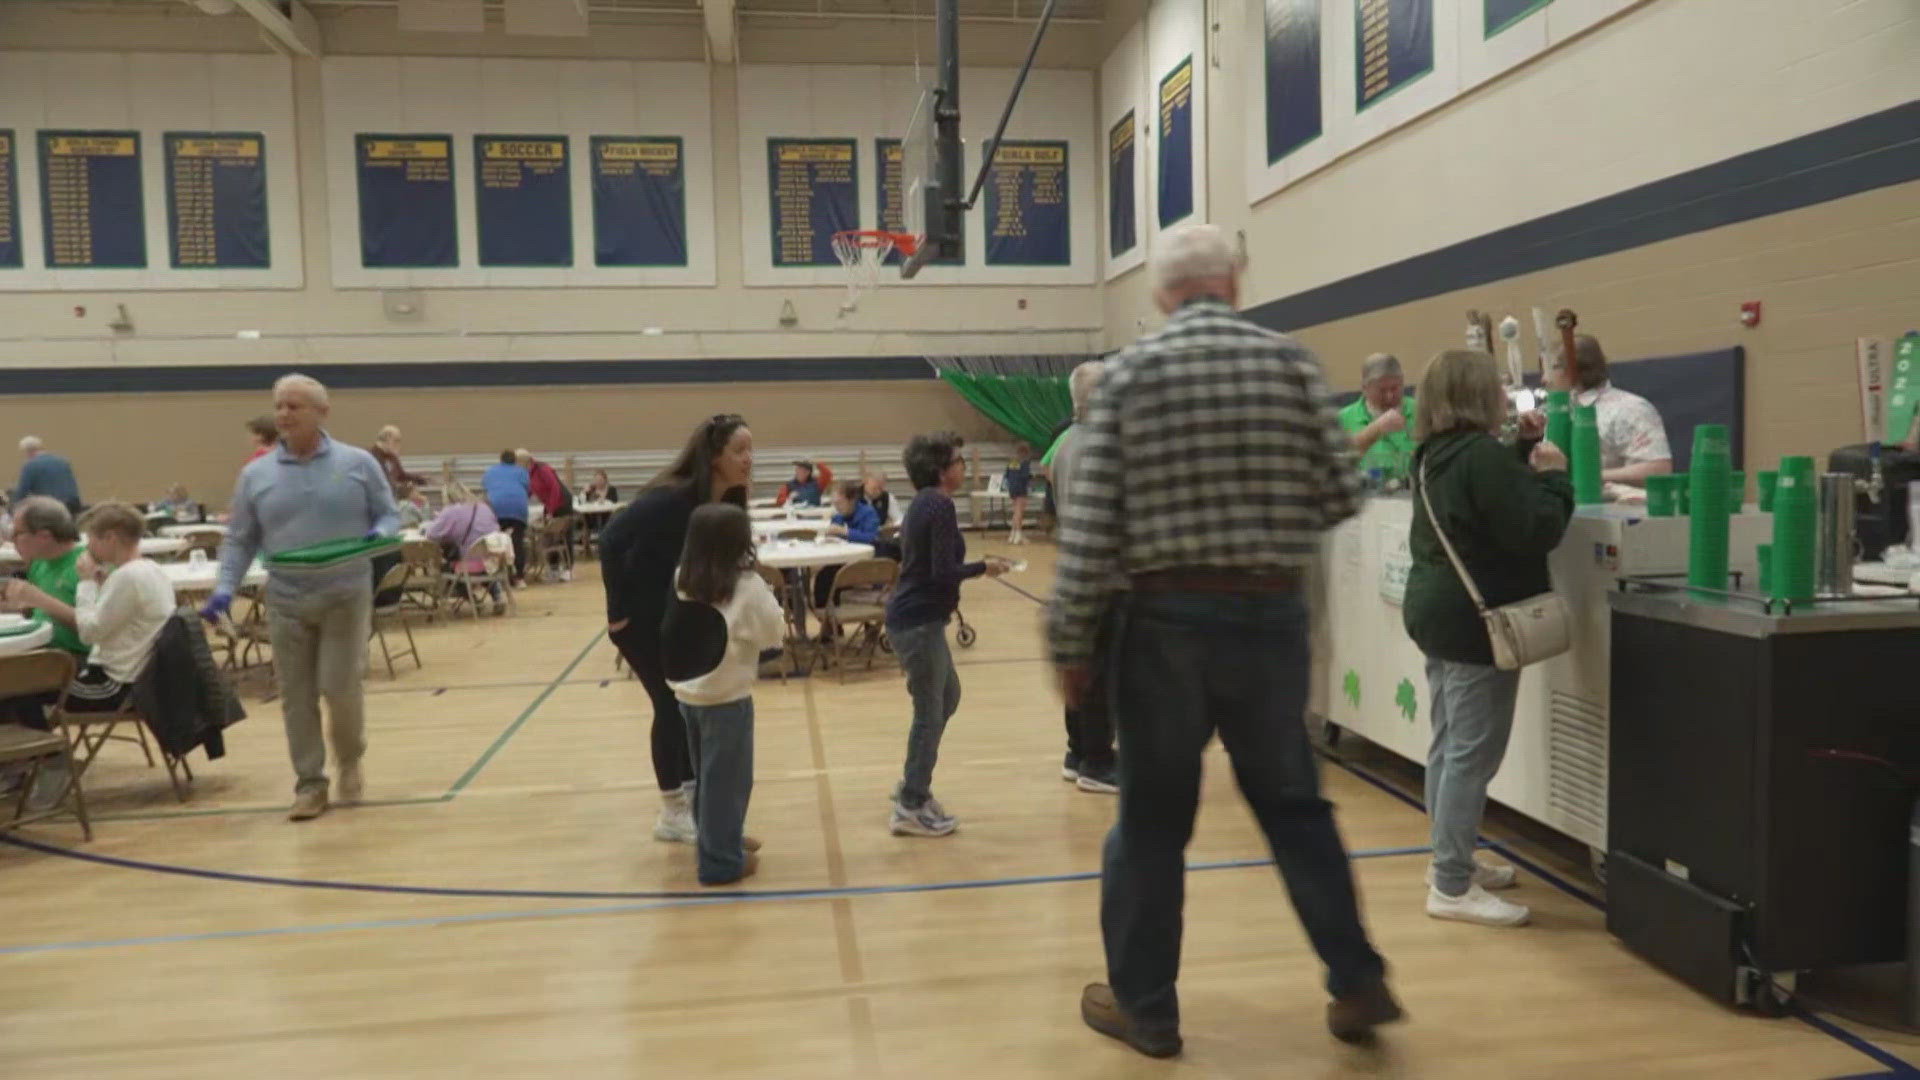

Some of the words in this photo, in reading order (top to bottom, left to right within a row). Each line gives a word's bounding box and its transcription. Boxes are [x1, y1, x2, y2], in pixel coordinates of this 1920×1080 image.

[501, 142, 553, 157] SOCCER
[640, 146, 675, 156] HOCKEY
[1034, 149, 1059, 160] GOLF
[1867, 342, 1881, 384] ULTRA
